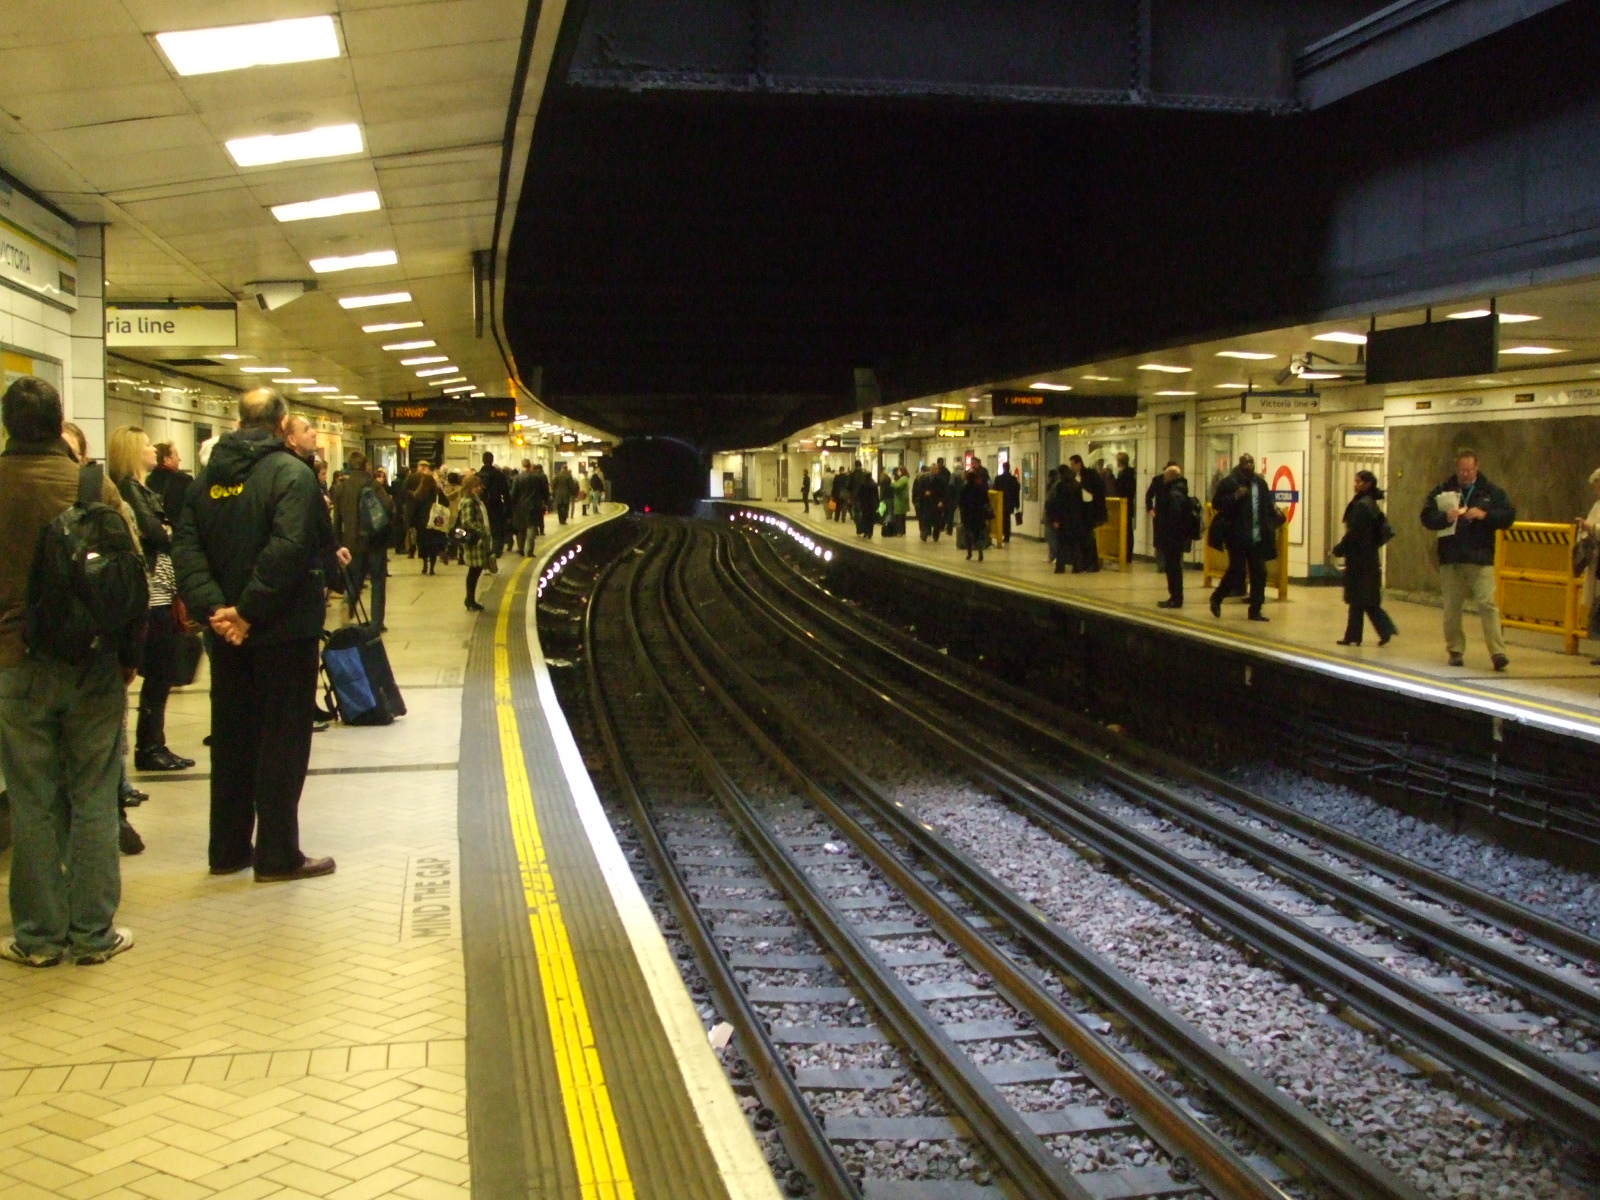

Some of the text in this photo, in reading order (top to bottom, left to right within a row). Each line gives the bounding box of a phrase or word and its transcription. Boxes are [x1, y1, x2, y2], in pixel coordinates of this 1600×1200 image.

[138, 316, 175, 333] line
[1260, 399, 1308, 408] Victoria line
[411, 857, 451, 939] MIND THE GAP
